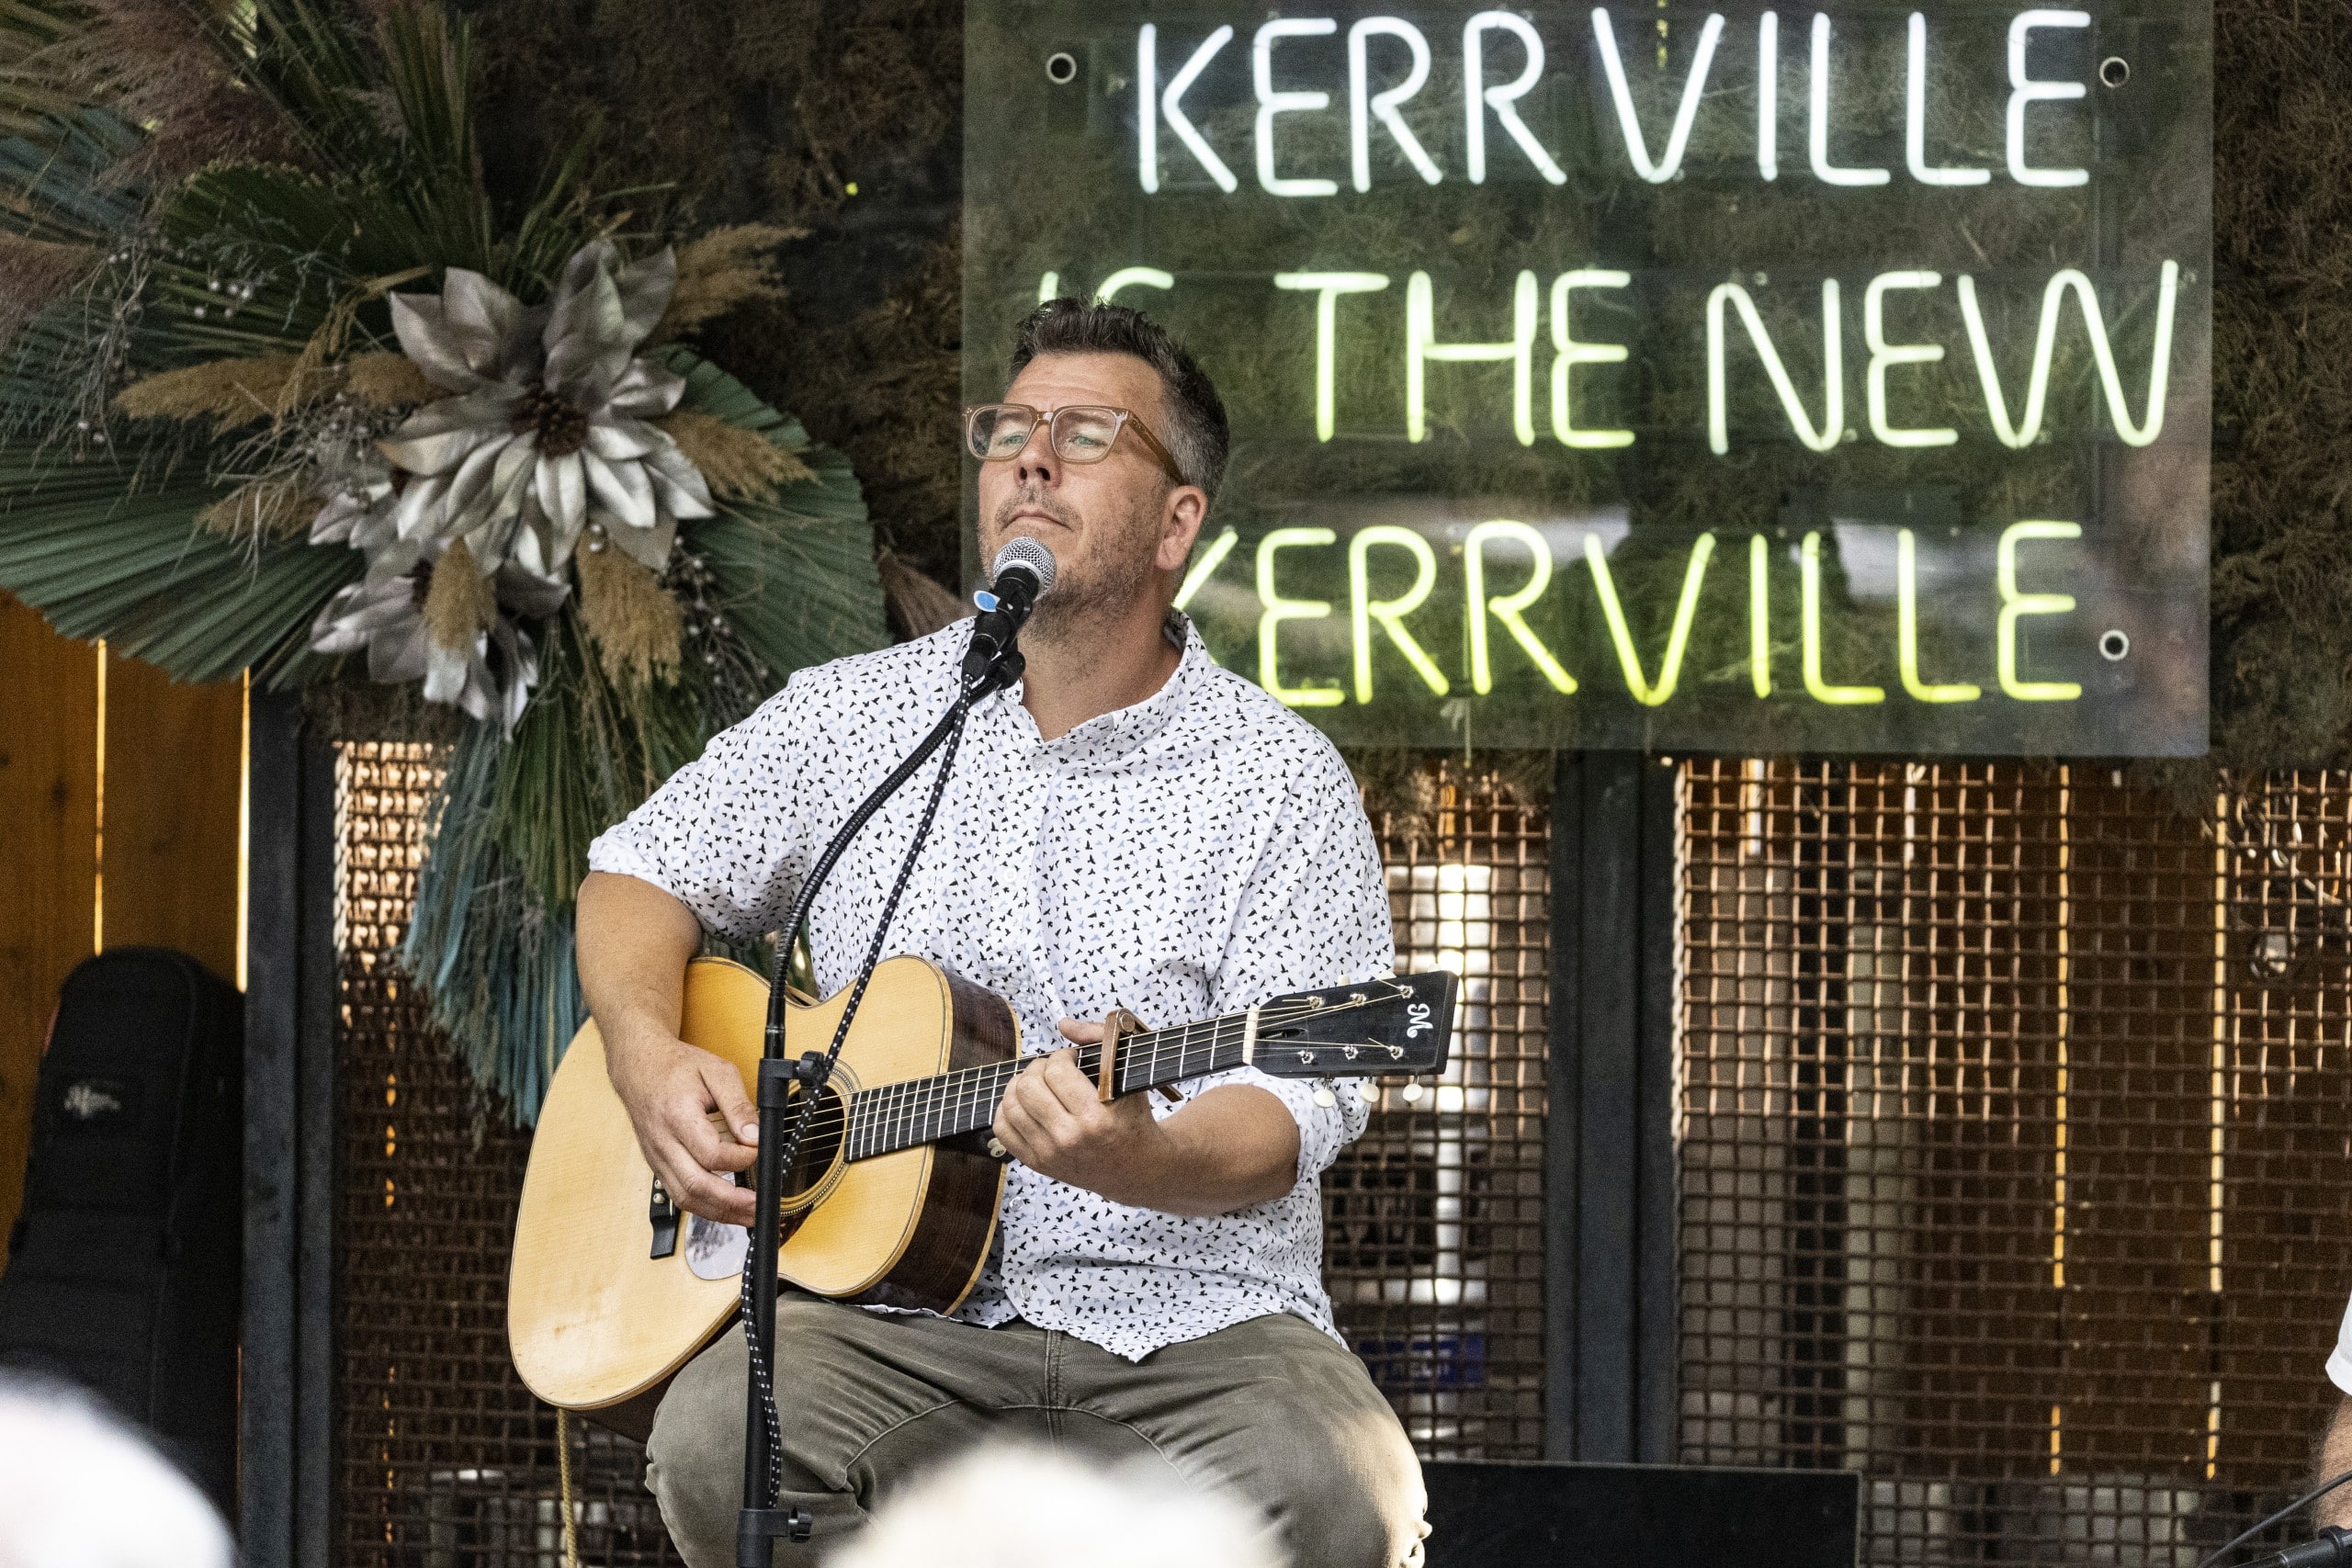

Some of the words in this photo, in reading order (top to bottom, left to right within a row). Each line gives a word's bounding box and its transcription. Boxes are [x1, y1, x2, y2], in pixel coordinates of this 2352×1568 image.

[1136, 7, 2091, 197] KERRVILLE
[1273, 267, 1635, 449] THE
[1706, 259, 2178, 455] NEW
